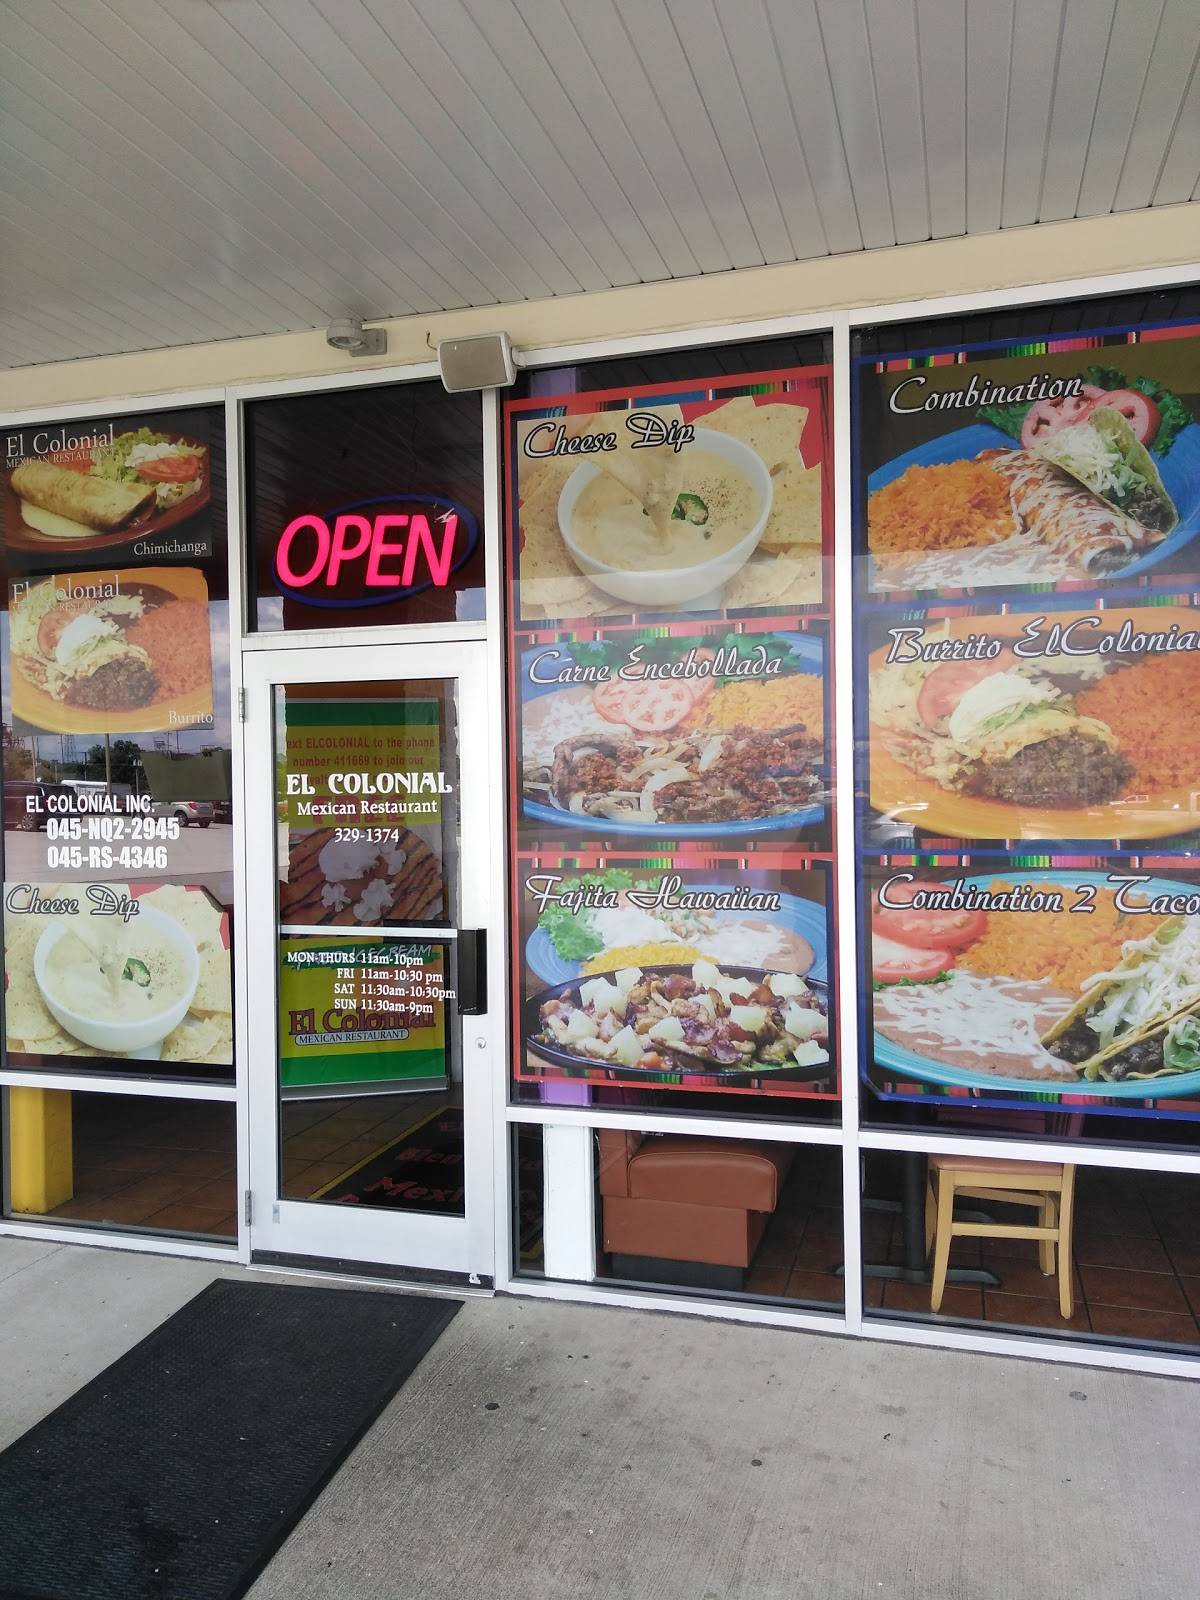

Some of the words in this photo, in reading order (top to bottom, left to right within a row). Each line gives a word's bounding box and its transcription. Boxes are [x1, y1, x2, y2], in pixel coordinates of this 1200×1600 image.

[888, 373, 1084, 415] Combination
[6, 434, 24, 458] El
[33, 423, 114, 455] Colonial
[524, 421, 617, 458] Cheese
[626, 413, 695, 453] Dip
[6, 454, 50, 469] MEXICAN
[53, 447, 114, 463] RESTAURANT
[134, 541, 207, 557] Chimichanga
[276, 514, 459, 588] OPEN
[37, 574, 120, 602] olonial
[886, 626, 1001, 664] Burrito
[528, 650, 612, 685] Carne
[619, 644, 782, 682] Encebollada
[168, 711, 213, 726] Burrito
[287, 739, 302, 749] ext
[306, 736, 369, 749] ELCOLONIAL
[373, 737, 383, 749] to
[388, 736, 402, 748] the
[293, 755, 331, 767] number
[374, 756, 383, 766] to
[286, 773, 315, 795] EL
[328, 772, 452, 795] COLONIAL
[26, 795, 44, 814] EL
[47, 795, 123, 814] COLONIAL
[125, 794, 155, 813] INC.
[297, 802, 356, 816] Mexican
[361, 800, 438, 815] Restaurant
[46, 816, 180, 841] 045-NQ2-2945
[335, 827, 400, 844] 329-1374
[47, 845, 168, 870] 045-RS-4346
[5, 883, 80, 915] Cheese
[86, 885, 140, 923] Dip
[525, 874, 619, 914] Fajita
[626, 875, 781, 911] Hawaiian
[878, 873, 1064, 913] Combination
[1071, 885, 1098, 914] 2
[287, 952, 356, 965] MON-THURS
[361, 953, 424, 968] 11am-10pm
[337, 967, 355, 979] FRI
[361, 968, 423, 981] 11am-10:30
[425, 973, 444, 985] pm
[334, 983, 355, 994] SAT
[361, 984, 456, 1001] 11:30am-10:30pm
[334, 998, 356, 1010] SUN
[361, 1000, 433, 1016] 11:30am-9pm
[288, 1008, 317, 1036] El
[322, 1004, 436, 1033] Colonial
[299, 1033, 342, 1044] MEXICAN
[345, 1030, 405, 1042] RESTAURANT
